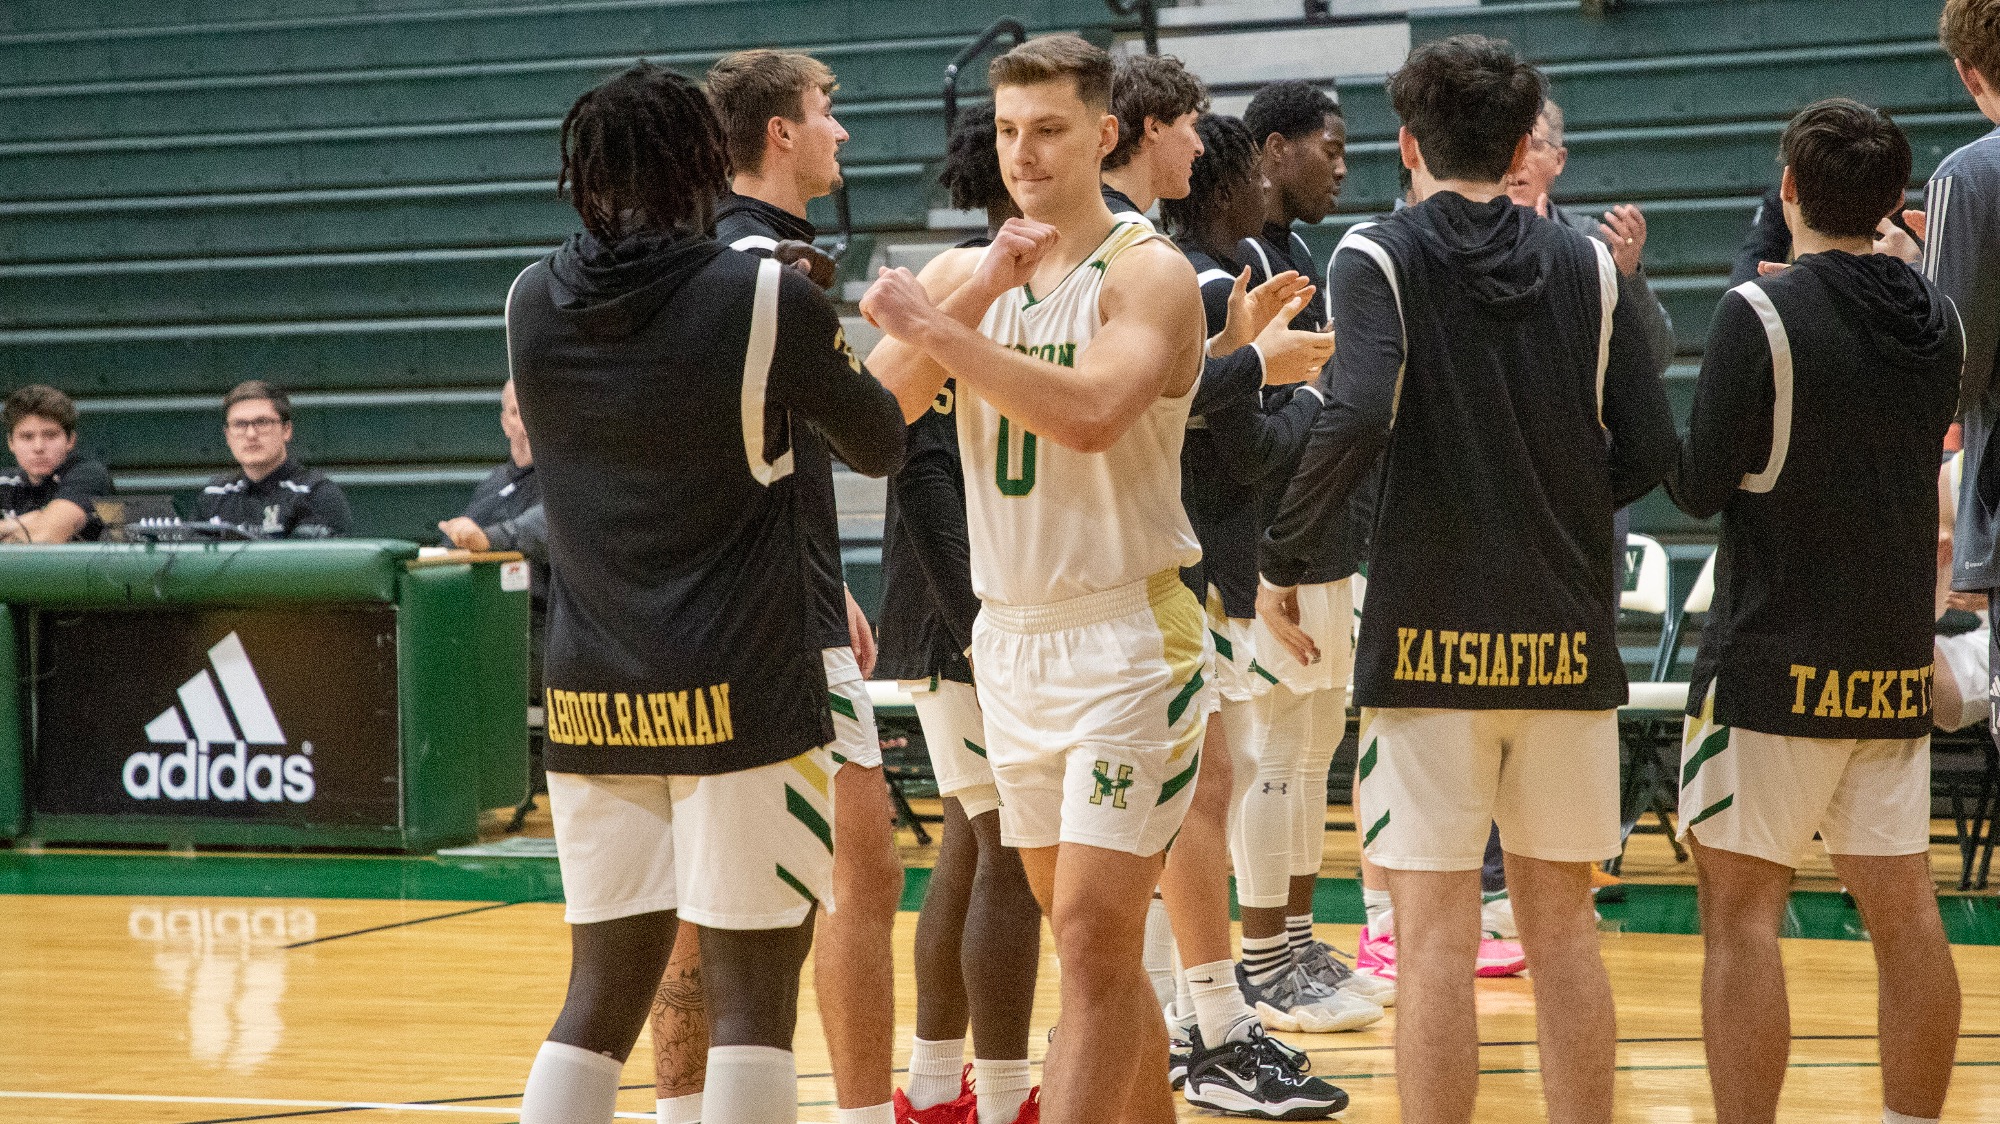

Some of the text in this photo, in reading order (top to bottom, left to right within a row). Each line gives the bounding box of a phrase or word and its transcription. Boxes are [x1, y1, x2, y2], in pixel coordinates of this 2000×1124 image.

[1394, 627, 1588, 686] KATSIAFICAS
[546, 682, 734, 747] ABDULRAHMAN
[1790, 662, 1934, 719] TACKET
[122, 740, 315, 803] adidas
